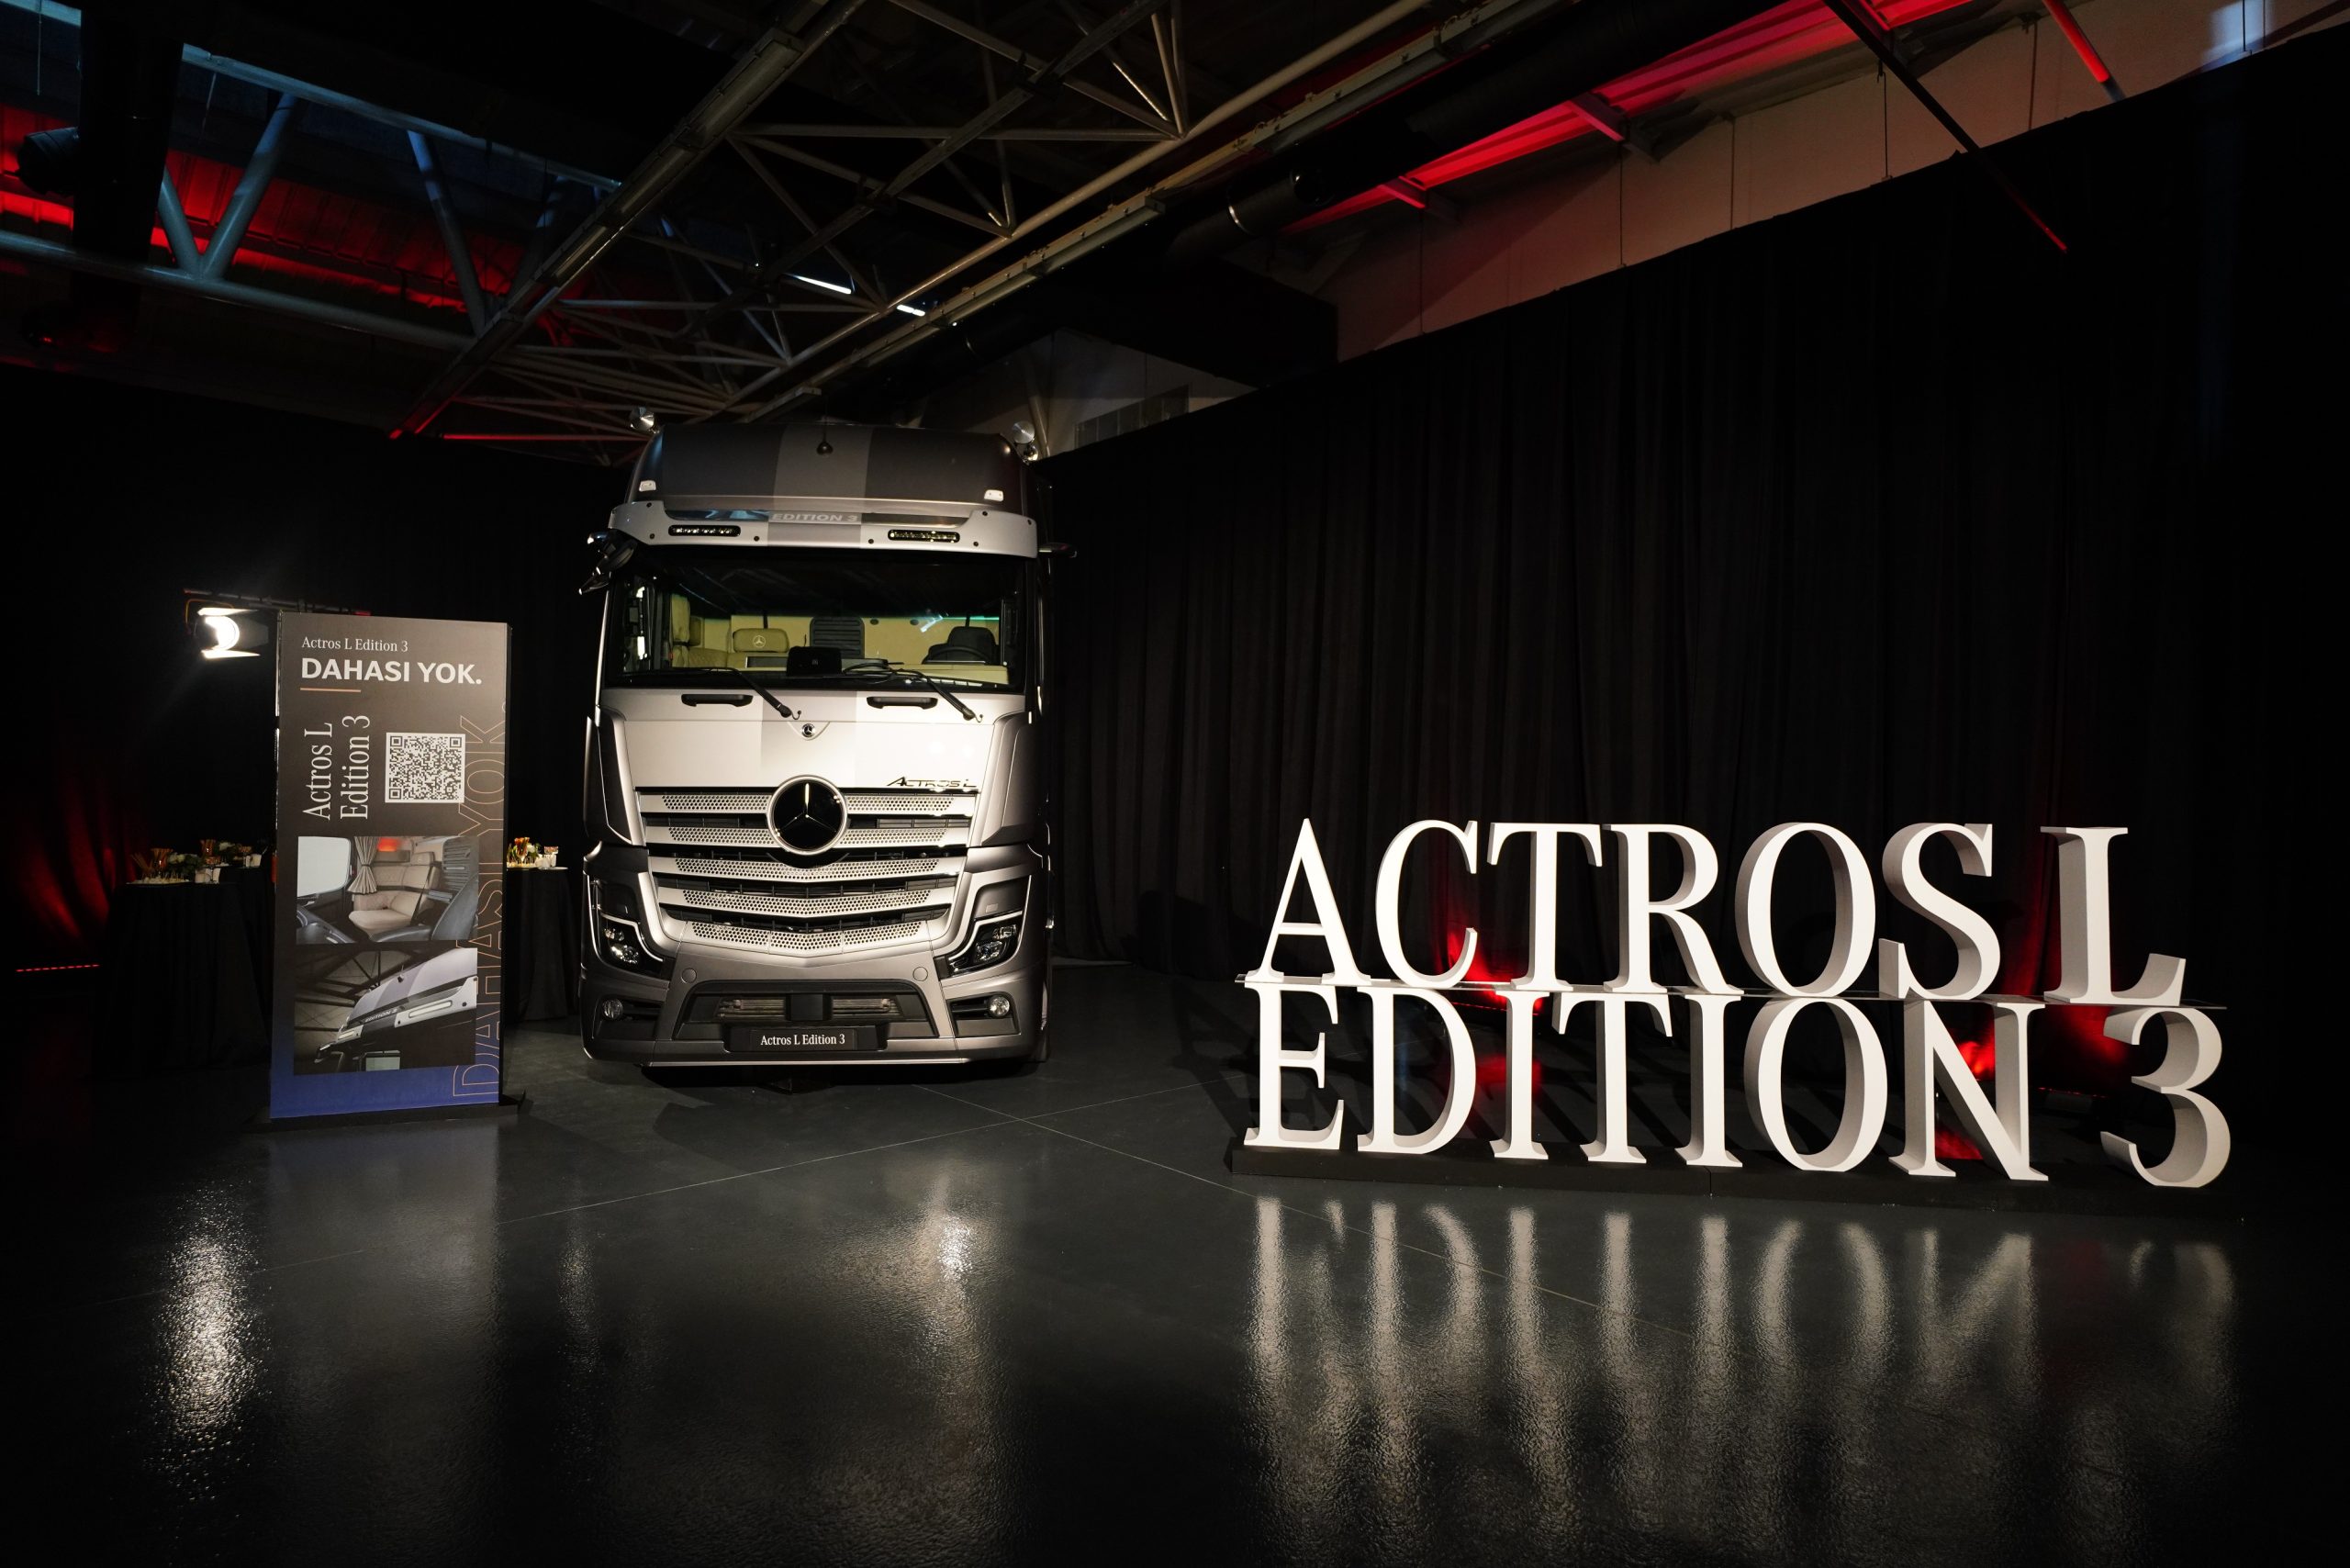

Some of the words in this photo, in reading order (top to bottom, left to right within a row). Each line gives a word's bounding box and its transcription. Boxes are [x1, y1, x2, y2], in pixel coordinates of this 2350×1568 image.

[772, 513, 842, 522] EDITION
[301, 636, 341, 650] Actros
[344, 638, 352, 650] L
[355, 638, 397, 652] Edition
[400, 640, 408, 652] 3
[301, 657, 410, 682] DAHASI
[417, 662, 483, 685] YOK.
[304, 722, 332, 737] L
[341, 715, 371, 729] 3
[302, 745, 332, 821] Actros
[340, 735, 370, 820] Edition
[1244, 817, 2001, 1001] ACTROS
[2040, 825, 2187, 1007] L
[760, 1035, 792, 1046] Actros
[793, 1034, 800, 1045] L
[802, 1034, 837, 1045] Edition
[839, 1033, 845, 1045] 3
[1244, 980, 2049, 1182] EDITION
[2100, 1007, 2232, 1188] 3
